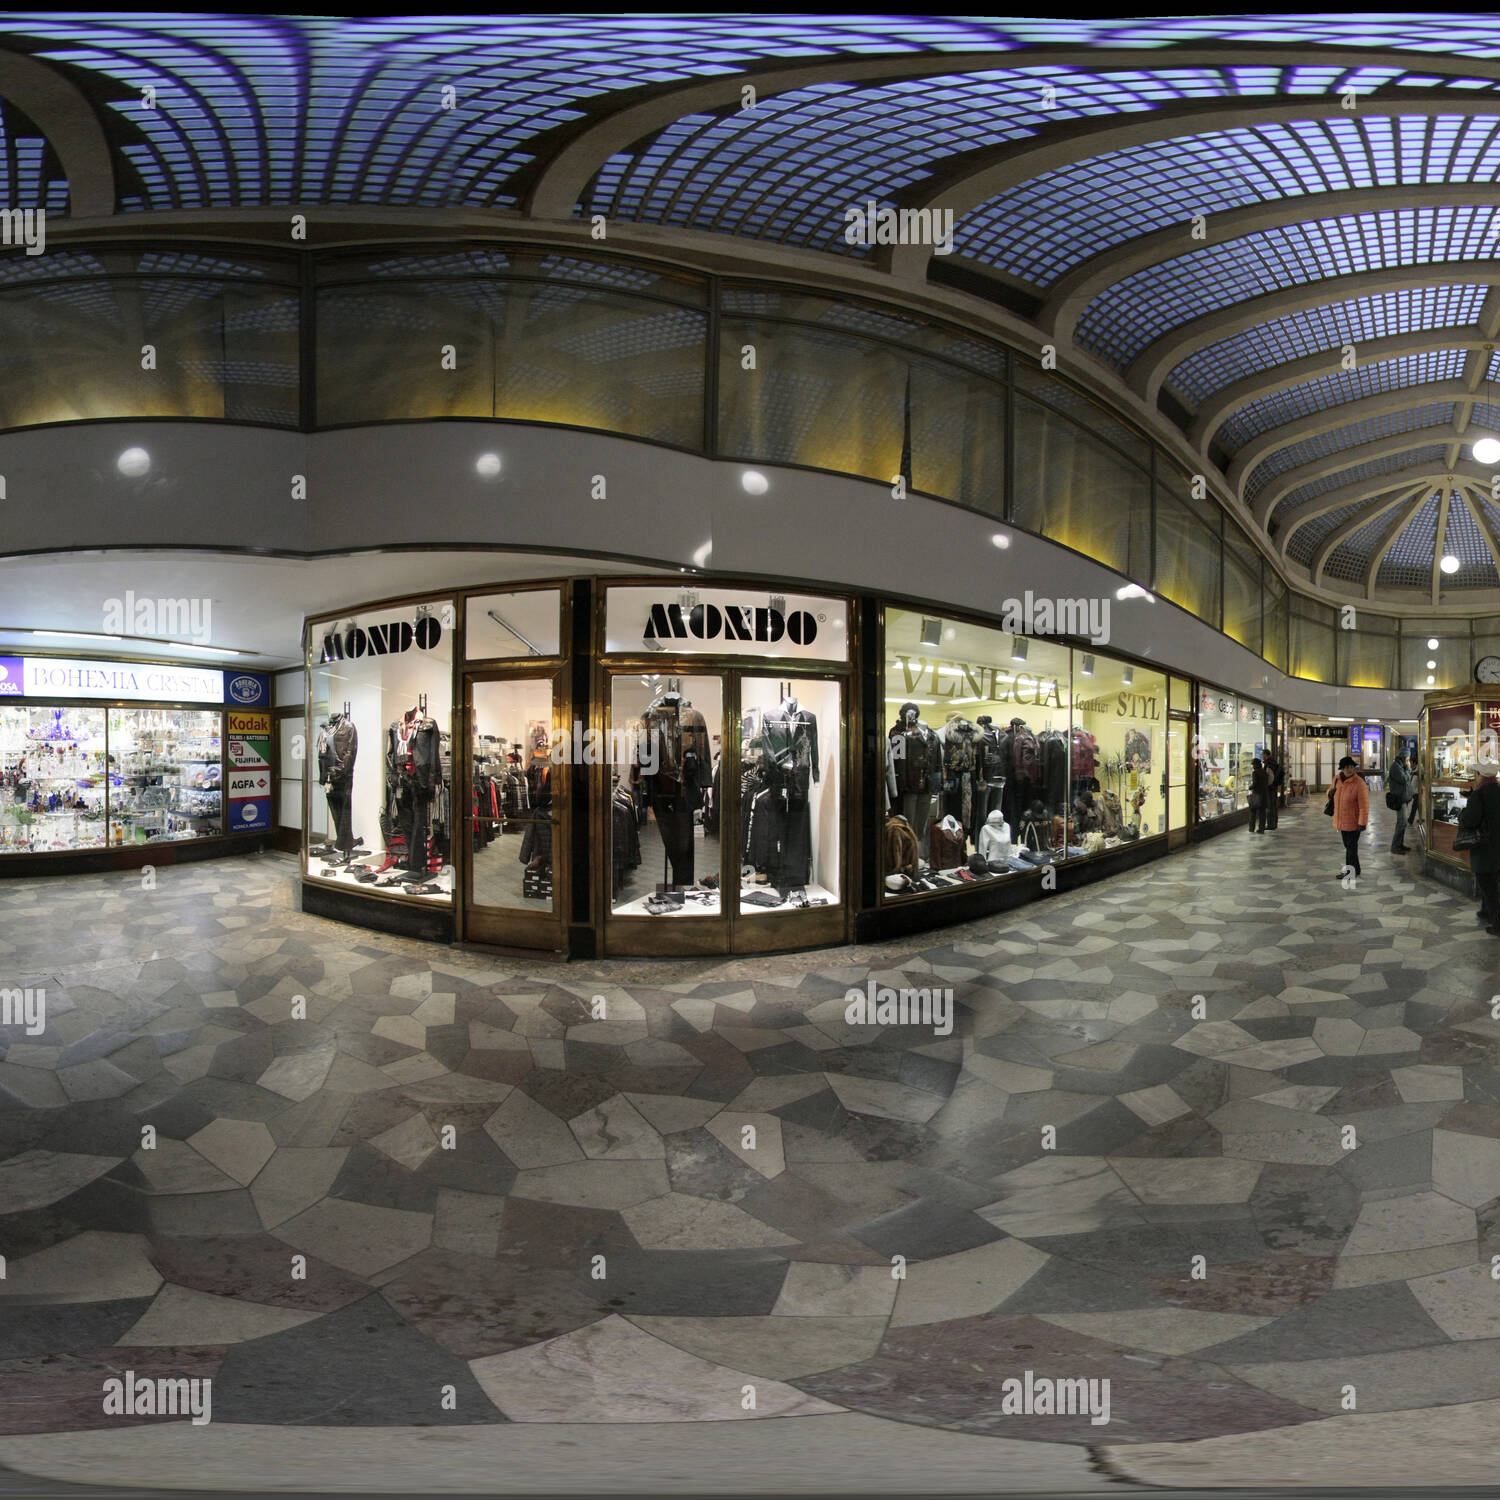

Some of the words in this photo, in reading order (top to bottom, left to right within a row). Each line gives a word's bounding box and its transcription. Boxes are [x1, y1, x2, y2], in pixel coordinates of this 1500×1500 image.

[643, 603, 817, 645] MONDO
[320, 617, 441, 664] MONDO
[33, 667, 140, 690] BOHEMIA
[147, 674, 220, 695] CRYSTAL
[896, 655, 1065, 709] VENECIA
[1116, 691, 1160, 721] STYL
[229, 716, 268, 731] Kodak
[1307, 727, 1331, 736] ALFA
[231, 780, 255, 789] AGFA
